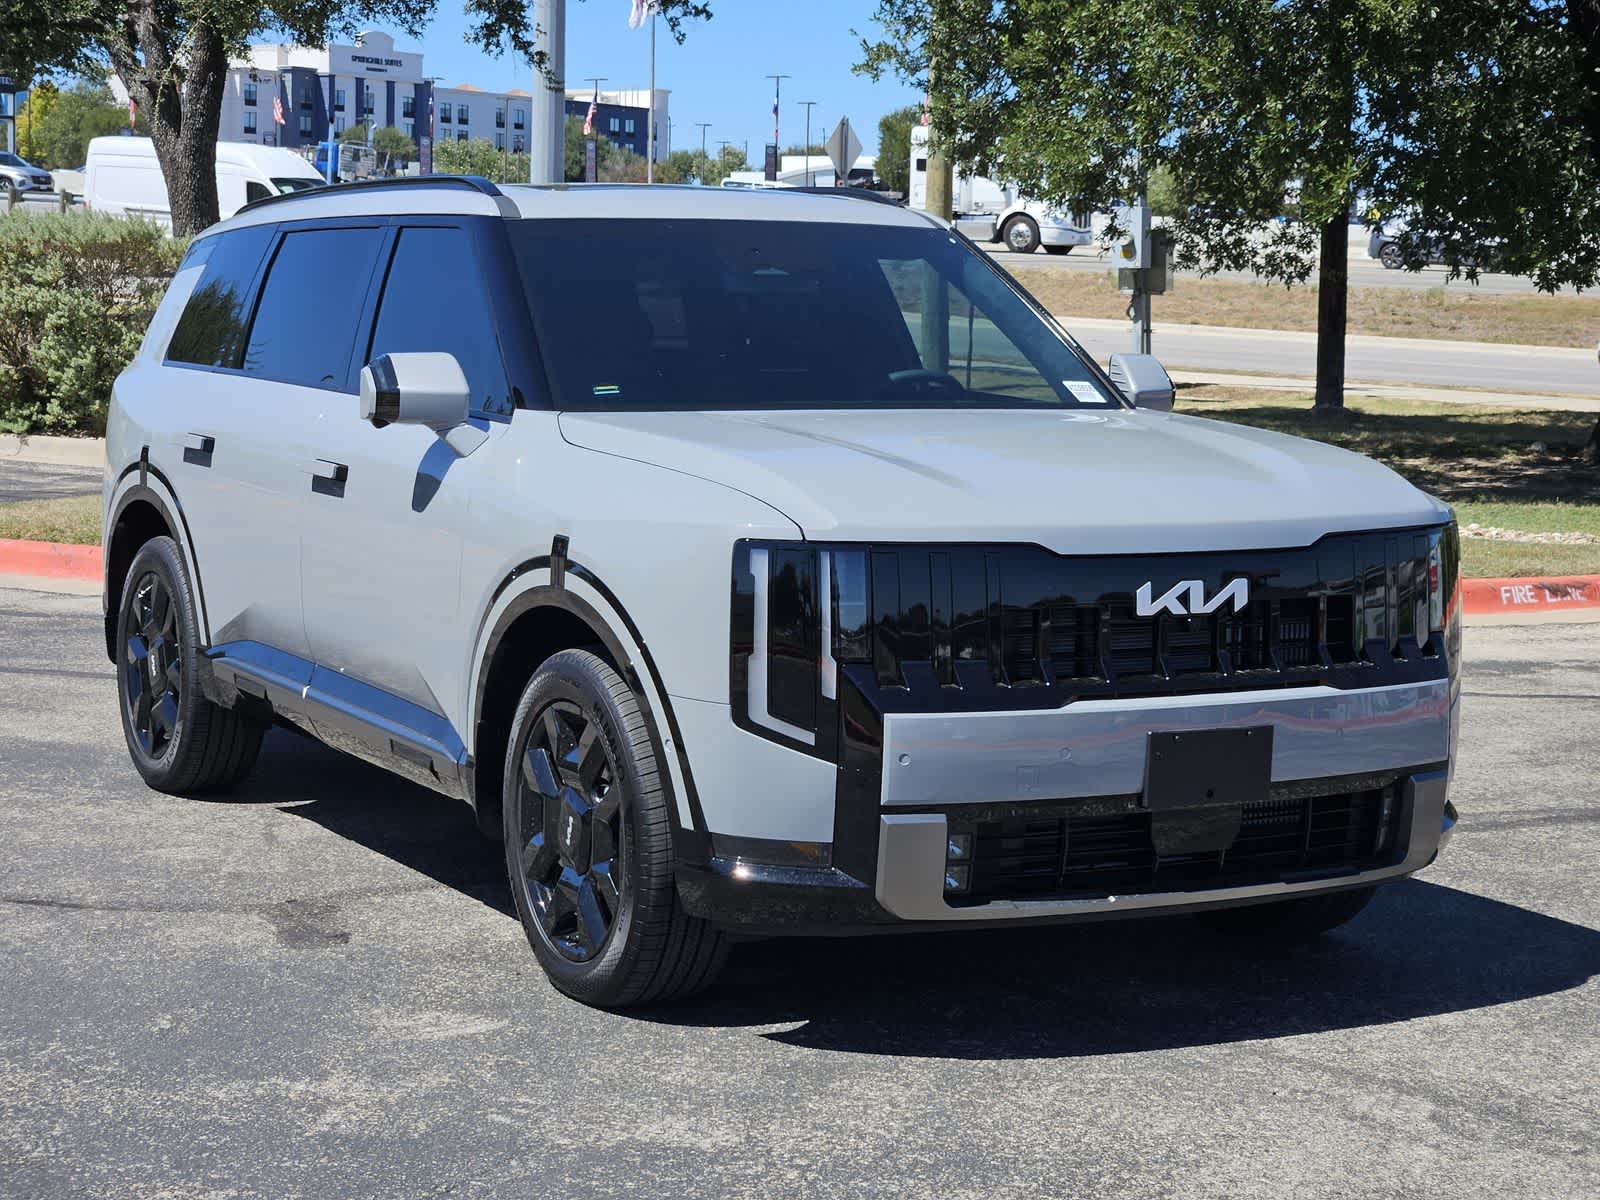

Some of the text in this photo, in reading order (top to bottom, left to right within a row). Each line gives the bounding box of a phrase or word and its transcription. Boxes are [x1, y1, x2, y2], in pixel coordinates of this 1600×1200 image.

[384, 58, 403, 67] SUITES
[1136, 577, 1249, 617] KIA
[1500, 583, 1587, 605] FIRE LNE
